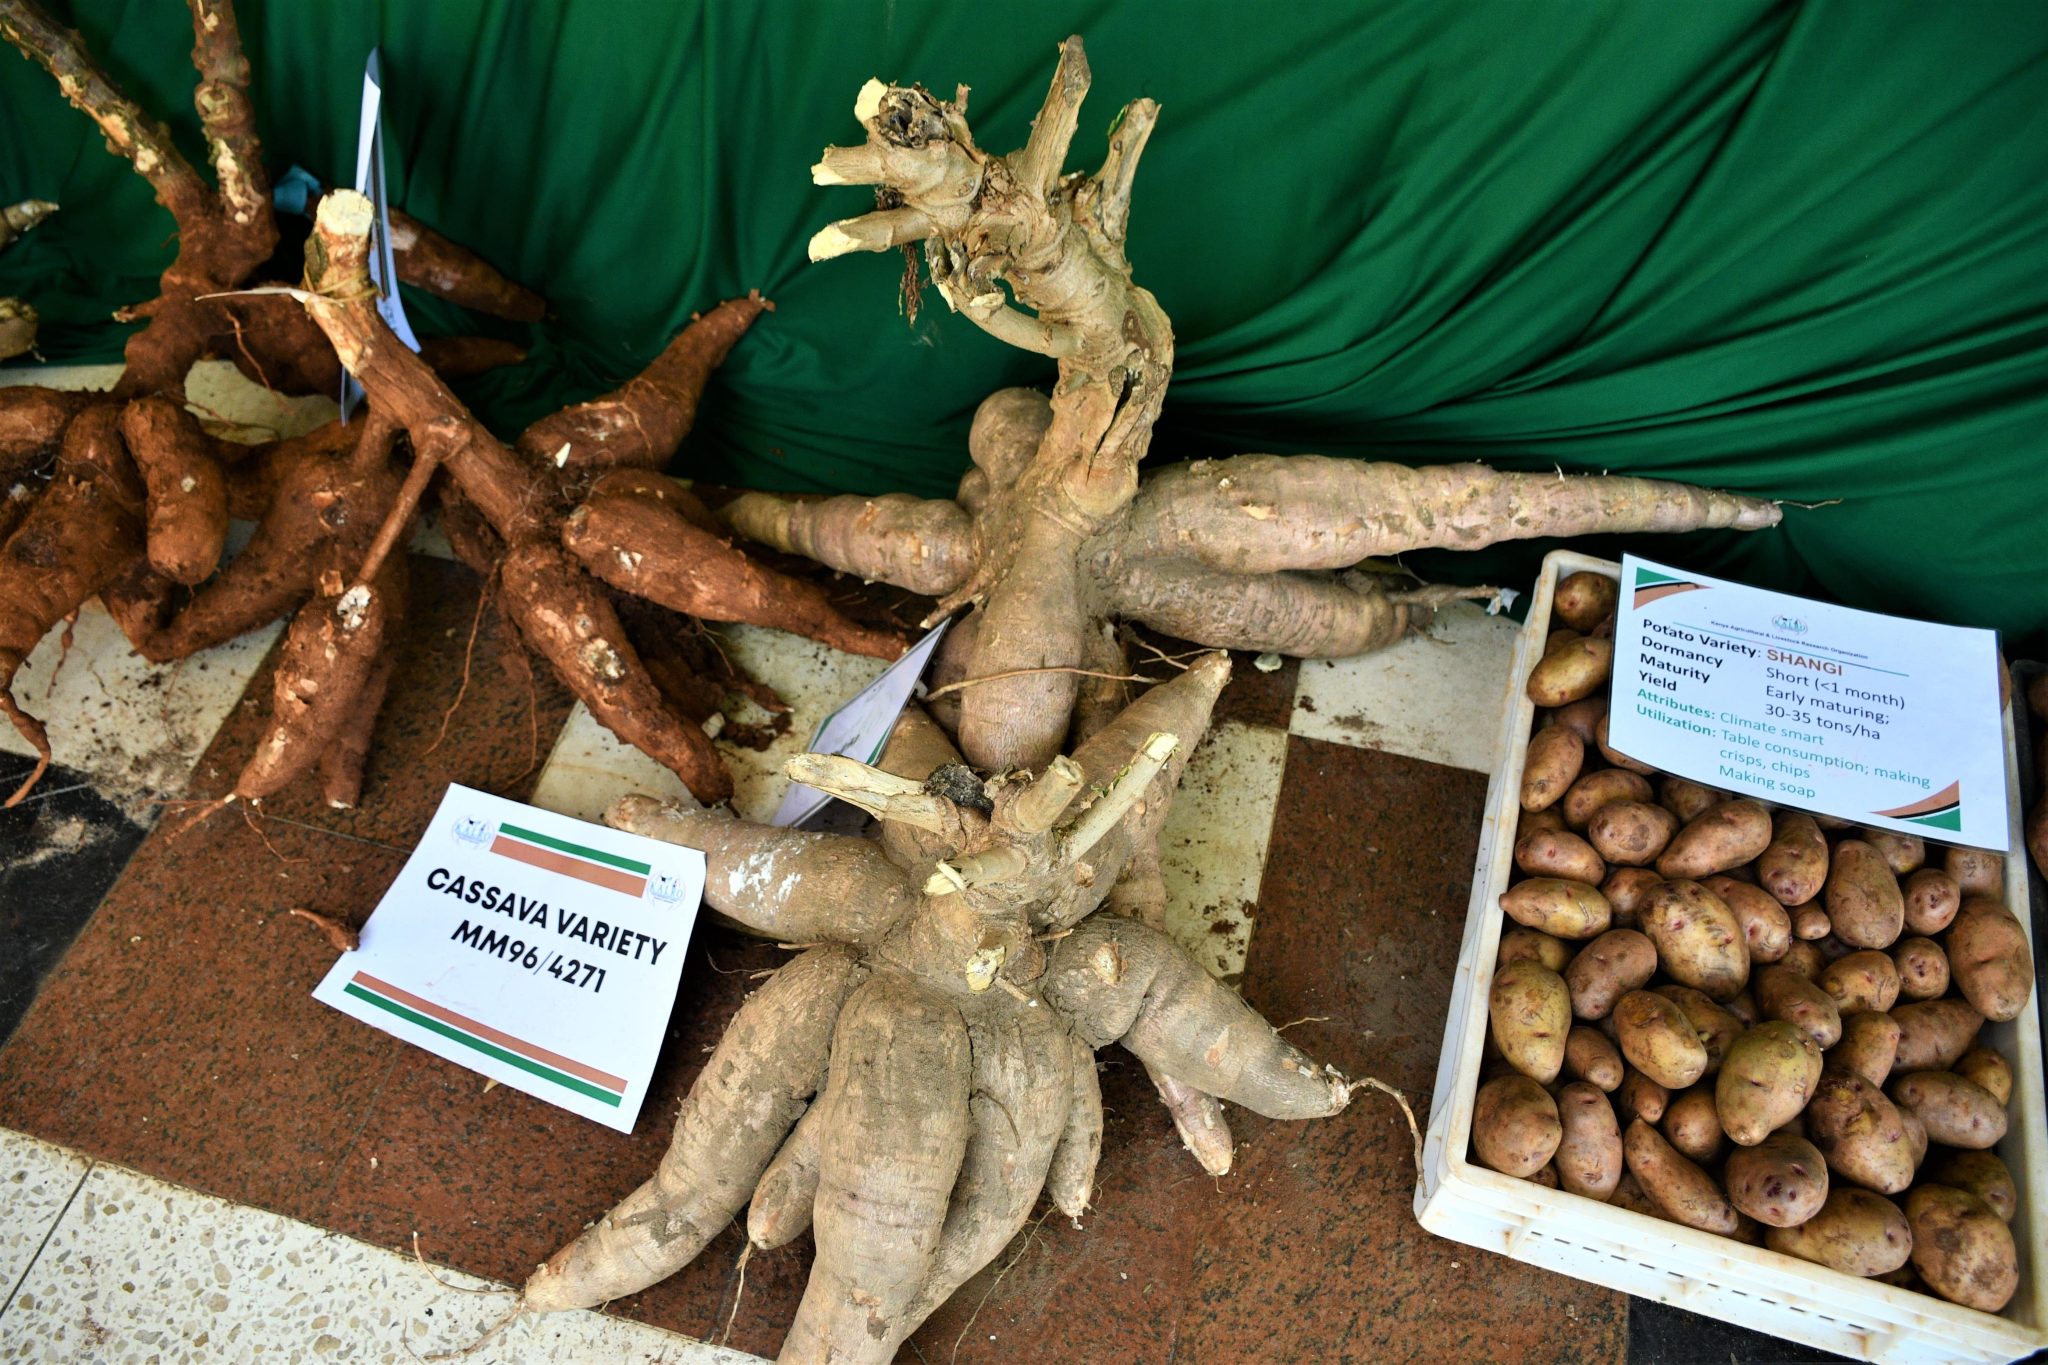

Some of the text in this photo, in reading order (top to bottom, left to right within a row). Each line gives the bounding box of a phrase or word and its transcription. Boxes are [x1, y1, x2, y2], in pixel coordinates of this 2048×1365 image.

[1641, 636, 1905, 710] Dormancy Short (<1 month)
[1643, 619, 1843, 676] Potato Variety: SHANGI
[1637, 688, 1824, 746] Attributes: Climate smart
[1638, 670, 1881, 740] Yield 30-35 tons/ha
[1640, 653, 1890, 726] Maturity Early maturing;
[1636, 703, 1931, 790] Utilization: Table consumption; making
[1719, 748, 1811, 779] crisps, chips
[1719, 764, 1816, 799] Making soap
[426, 868, 667, 966] CASSAVA VARIETY
[450, 920, 607, 993] MM96/4271
